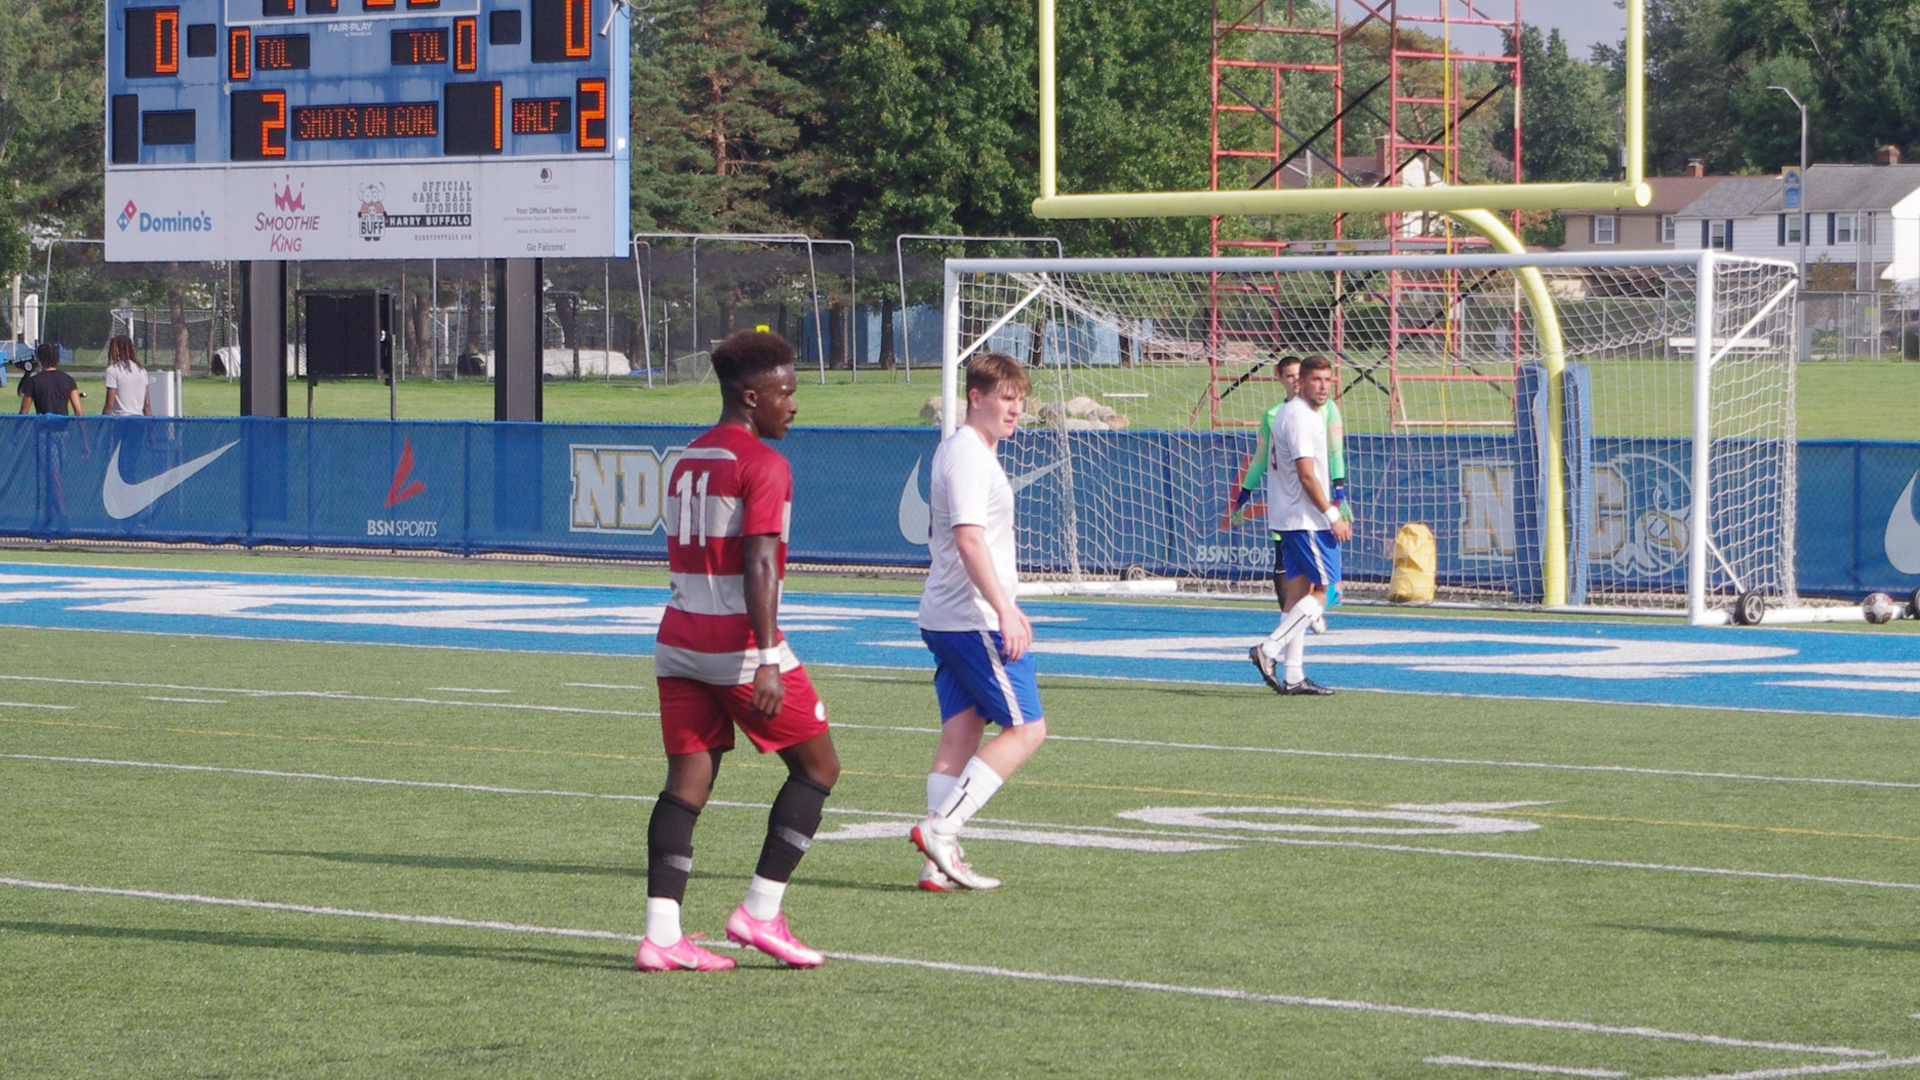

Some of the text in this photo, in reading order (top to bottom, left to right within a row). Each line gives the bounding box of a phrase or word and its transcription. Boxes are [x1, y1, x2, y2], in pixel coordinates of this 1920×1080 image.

[155, 11, 178, 73] 0
[231, 28, 250, 78] 0
[258, 38, 291, 68] TOL
[409, 32, 445, 62] TOL
[456, 19, 476, 71] 0
[261, 92, 285, 156] 2
[300, 105, 437, 138] SHOTS ON GOAL
[494, 84, 502, 150] 1
[514, 101, 561, 133] HALF
[580, 82, 605, 148] 2
[413, 192, 472, 203] GAME BALL
[422, 181, 472, 192] OFFICIAL
[139, 210, 212, 232] Domino's
[255, 212, 320, 231] SMOOTHIE
[389, 215, 470, 226] HARRY BUFFALO
[425, 203, 472, 213] SPONSOR
[516, 207, 528, 215] Your
[361, 221, 383, 235] BUFF
[526, 242, 566, 252] Go Falcons!
[569, 444, 688, 535] ND
[676, 470, 710, 547] 11
[1229, 546, 1276, 564] SPORT
